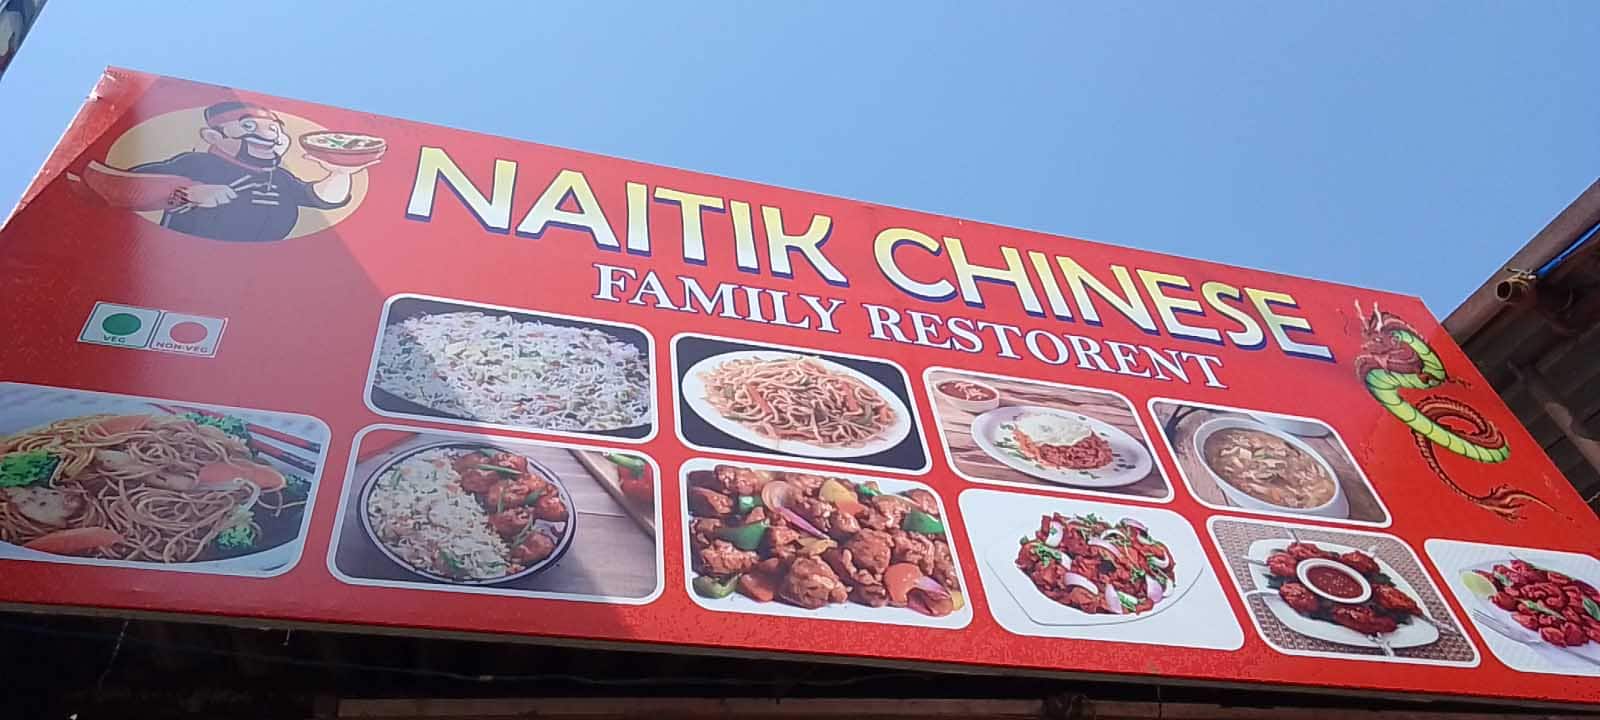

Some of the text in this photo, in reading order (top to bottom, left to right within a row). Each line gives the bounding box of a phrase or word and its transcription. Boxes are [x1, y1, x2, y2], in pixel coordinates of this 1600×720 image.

[405, 145, 1337, 363] NAITIK CHINESE
[103, 334, 126, 344] VEG
[155, 341, 209, 354] NON-VEG
[592, 263, 1230, 390] FAMILY RESTORENT
